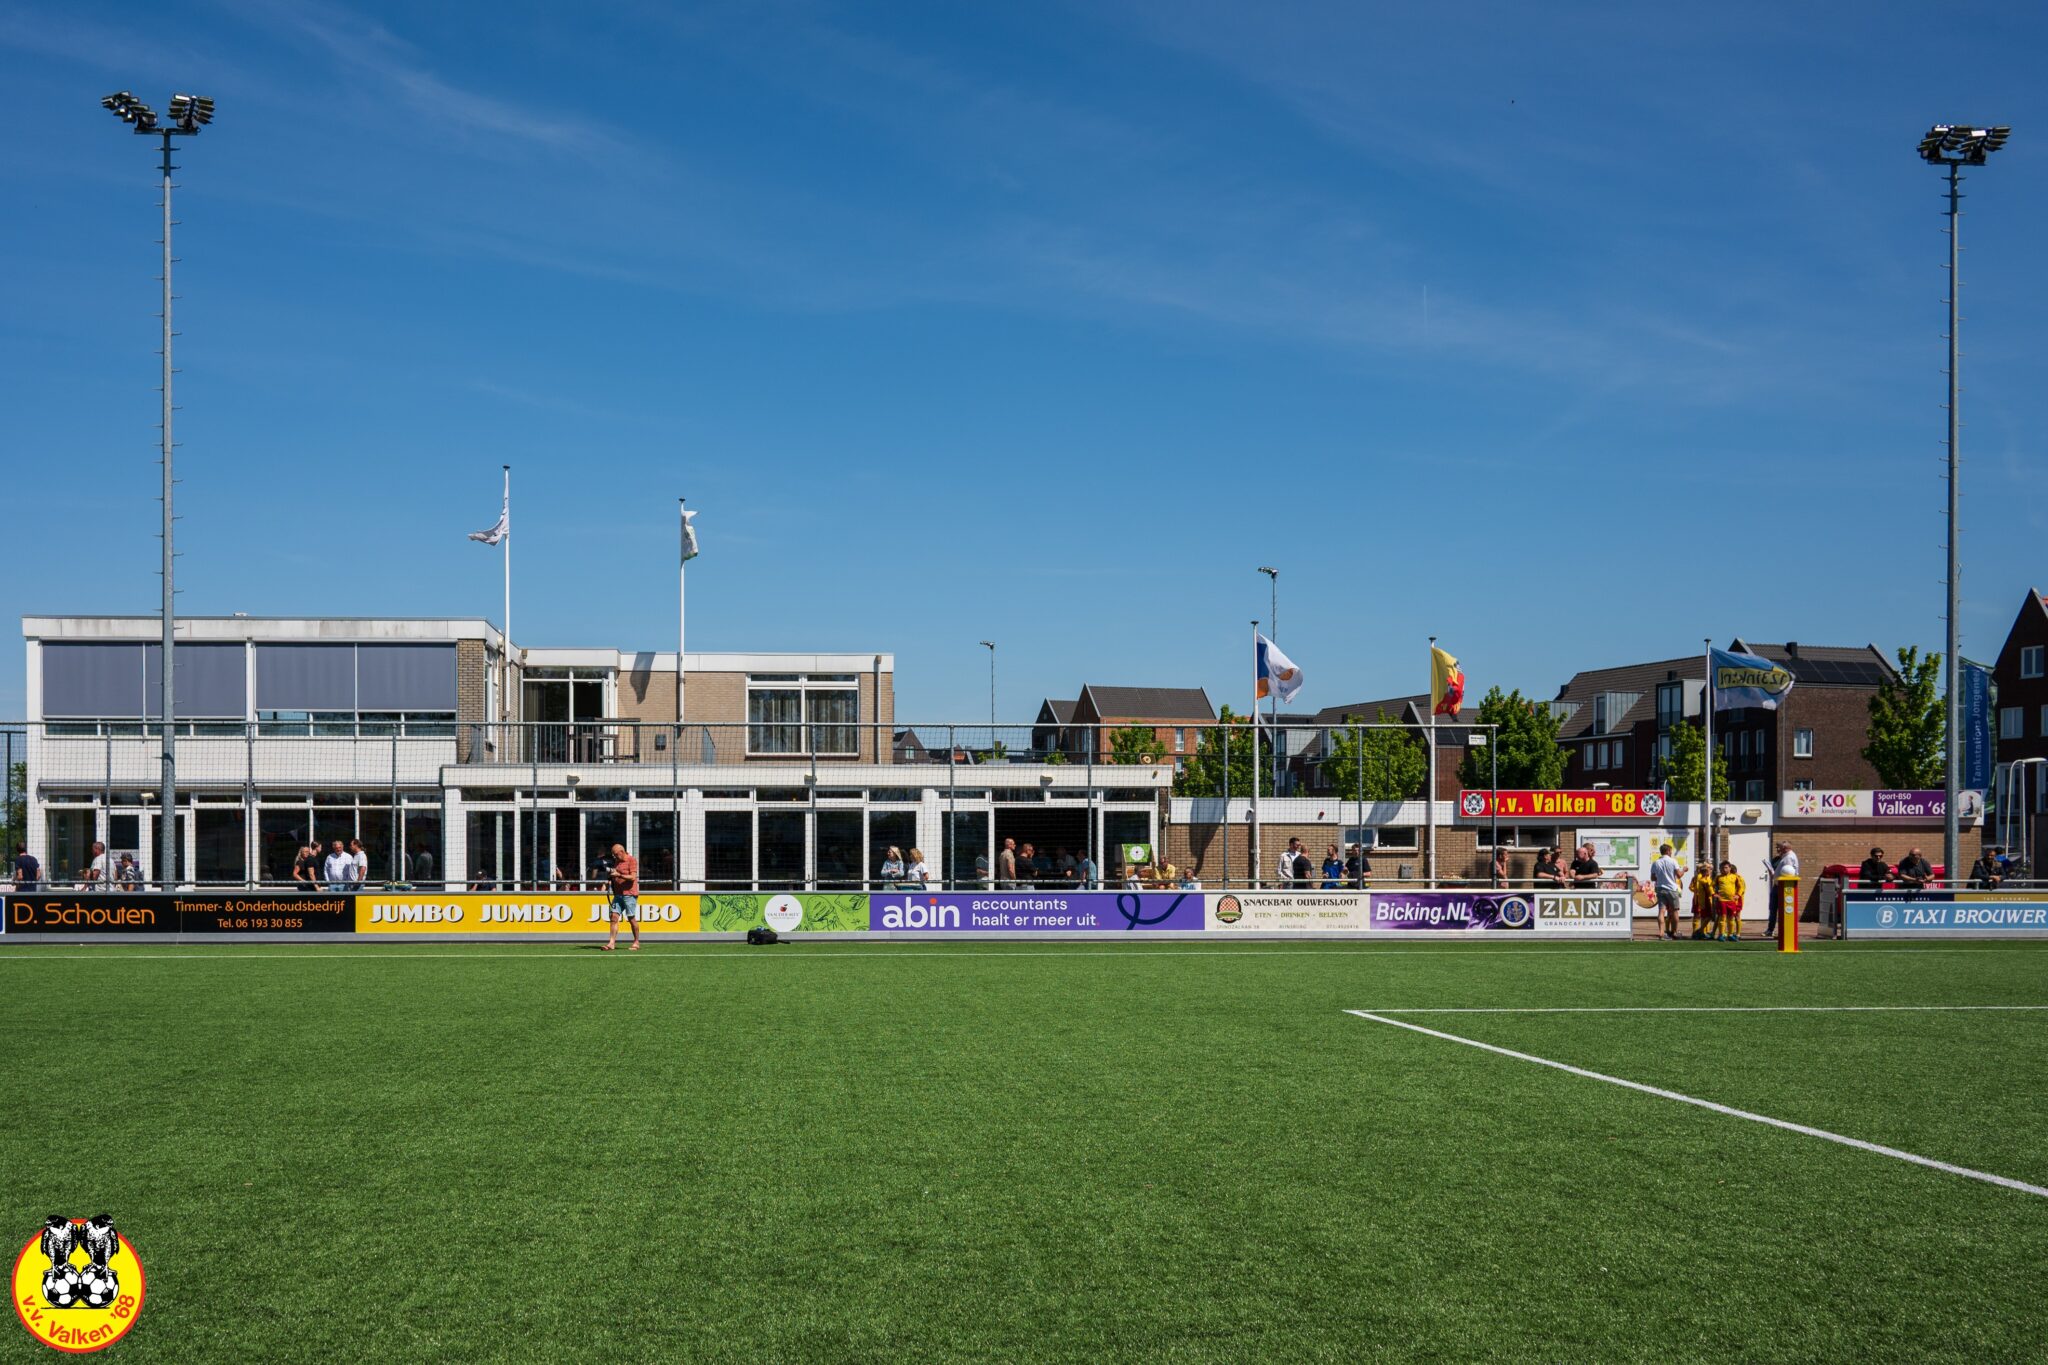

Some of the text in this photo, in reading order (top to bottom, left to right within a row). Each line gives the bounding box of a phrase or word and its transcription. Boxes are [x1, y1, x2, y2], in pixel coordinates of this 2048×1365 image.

[1972, 719, 1982, 783] Tankstations
[1489, 793, 1636, 813] v.v. Valken '68
[1821, 794, 1857, 808] KOK
[1877, 793, 1912, 801] Sport-BSO
[1877, 801, 1924, 816] Valken
[174, 900, 346, 915] Timmer- & Onderhoudsbedrijf
[972, 898, 1068, 911] accountants
[1243, 898, 1359, 907] SNACKBAR OUWERSLOOT
[1542, 900, 1623, 916] ZAND
[13, 903, 156, 925] D. Schouten
[369, 904, 465, 924] JUMBO
[478, 904, 574, 924] JUMBO
[882, 896, 960, 929] abin
[972, 913, 1100, 926] haalt er meer uit.
[1376, 902, 1470, 925] Bicking.NL
[1881, 909, 2047, 925] B TAXI BROUWER
[217, 918, 304, 929] Tel. 06 193 30 855
